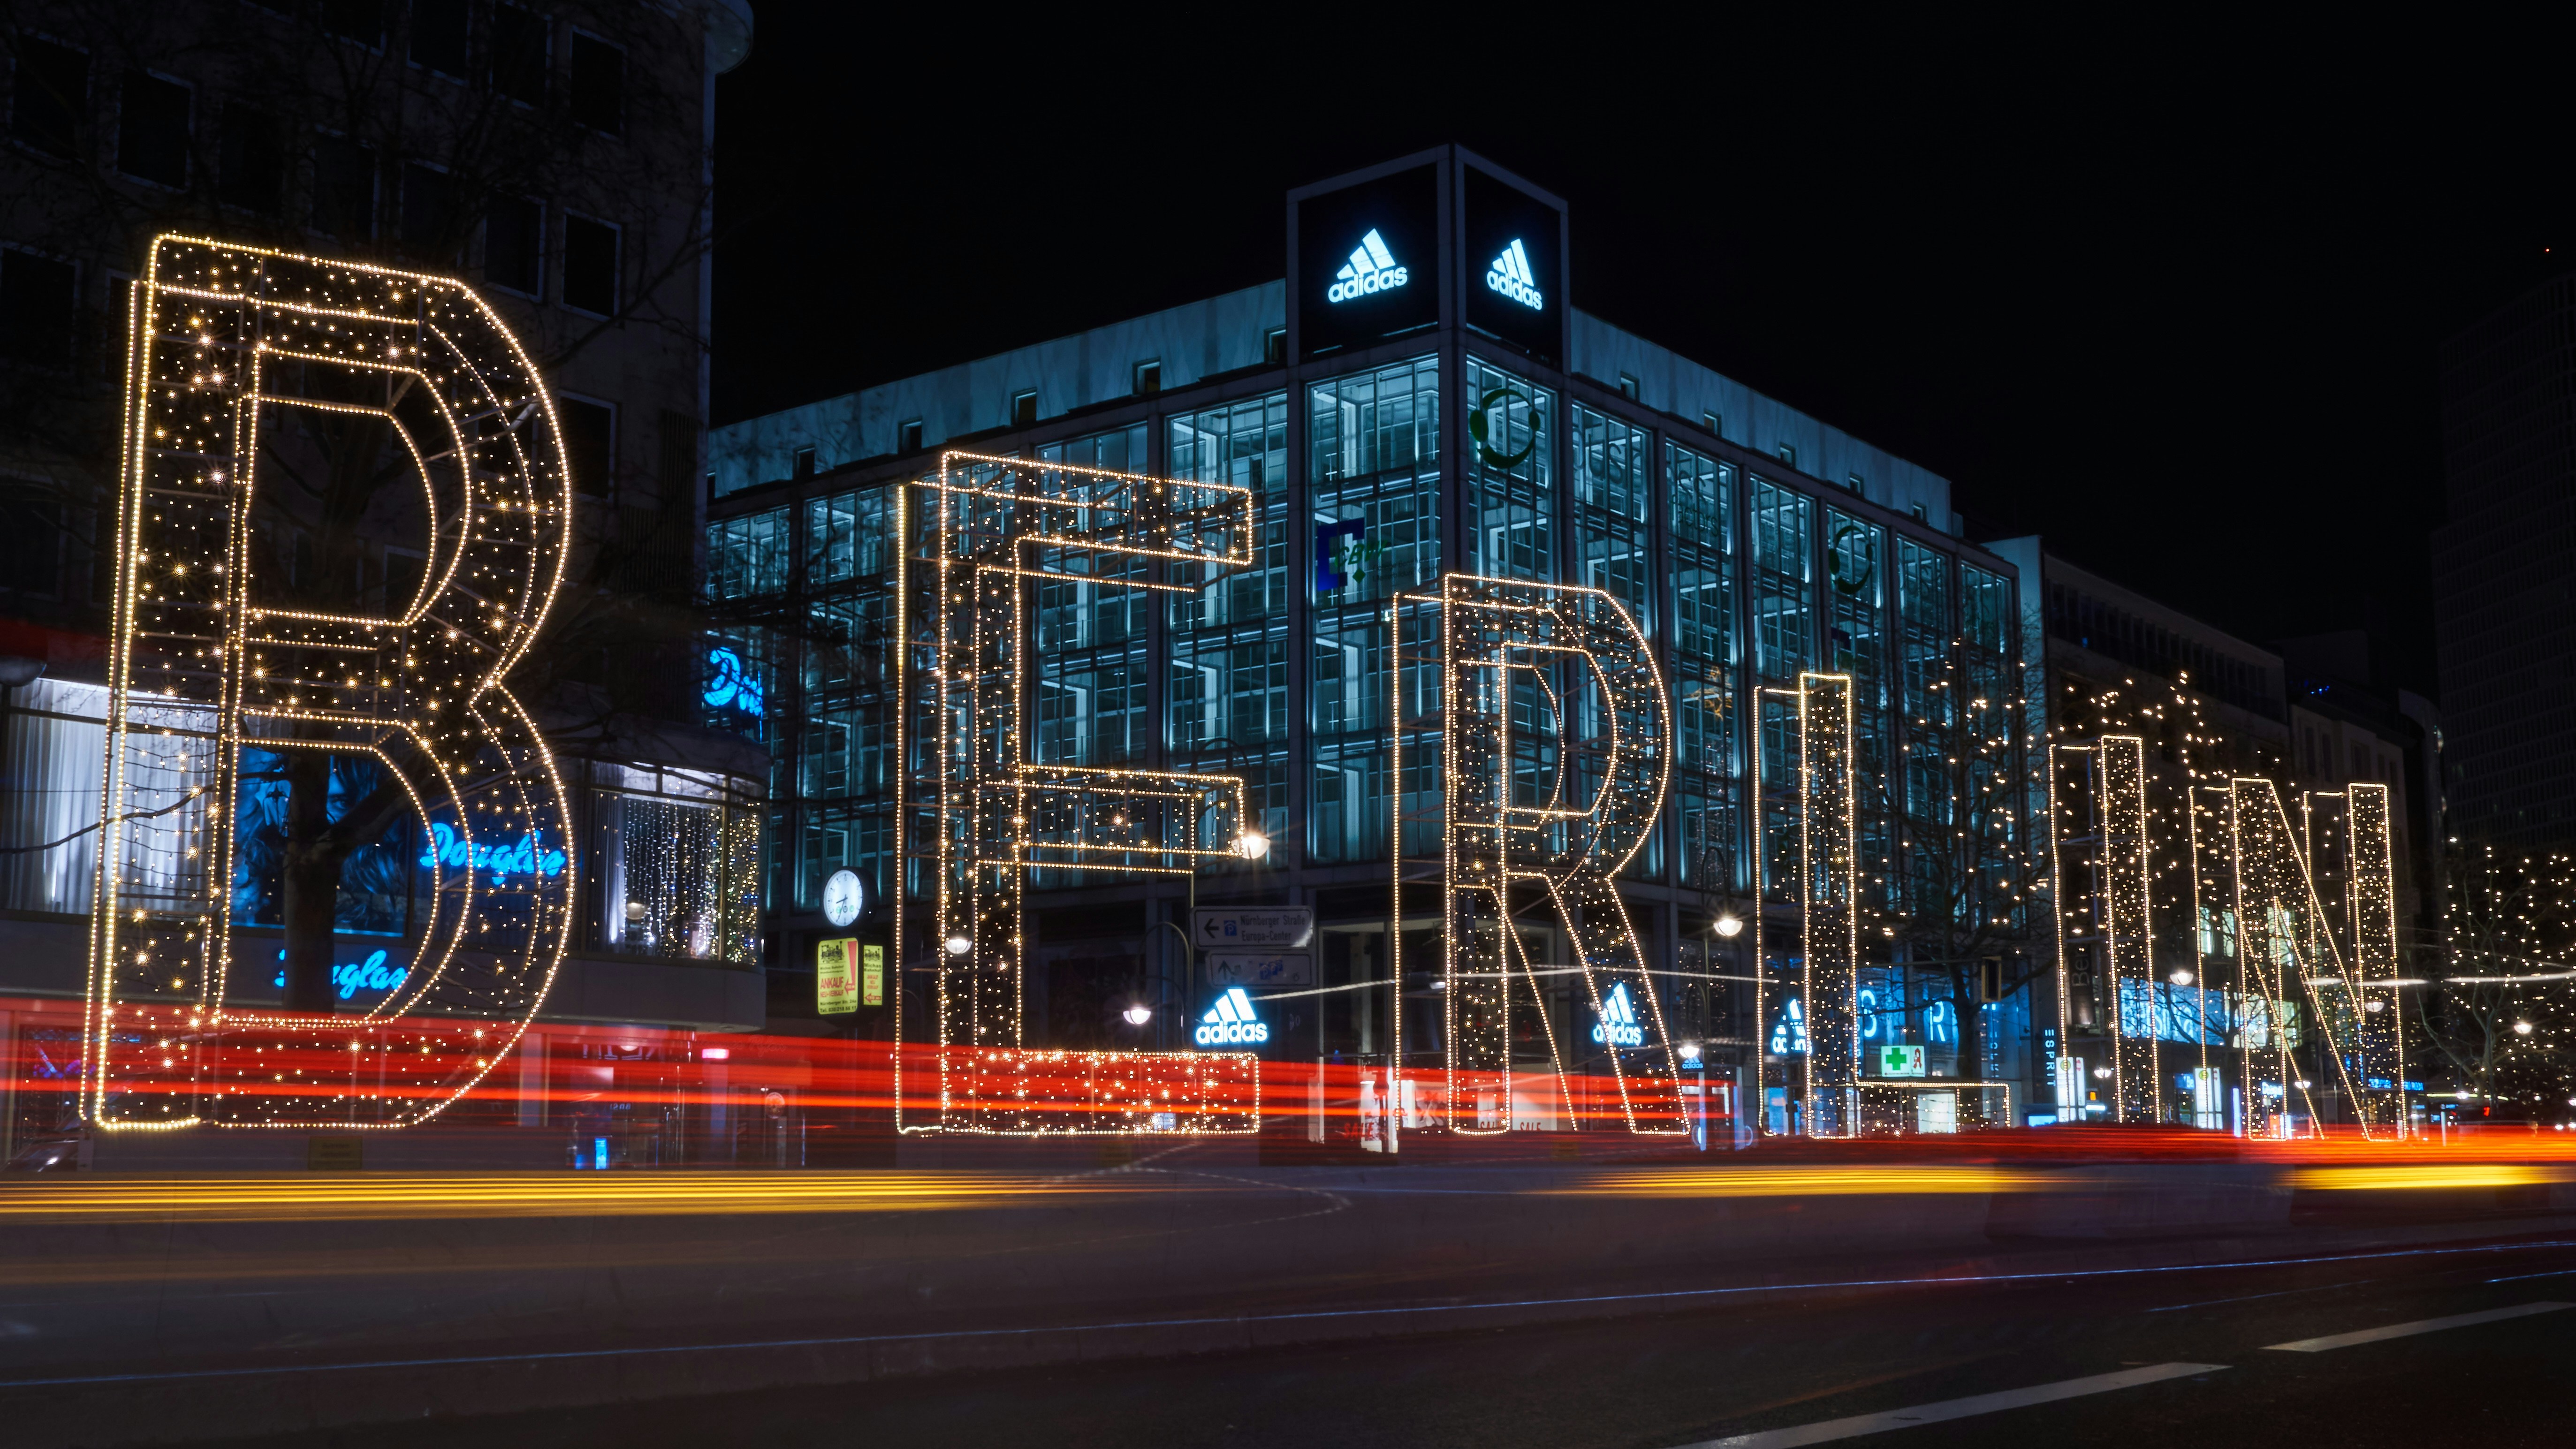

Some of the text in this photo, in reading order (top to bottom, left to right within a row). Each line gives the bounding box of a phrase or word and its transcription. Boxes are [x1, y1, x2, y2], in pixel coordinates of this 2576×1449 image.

[1328, 266, 1408, 303] adidas
[1486, 271, 1543, 311] adidas
[420, 823, 566, 885] Douglas
[1240, 915, 1279, 928] Nürnberger
[1283, 915, 1306, 926] Straße
[1242, 930, 1292, 943] Europa-Center
[820, 976, 843, 989] ANKAUF
[1196, 1021, 1269, 1044] adidas
[2045, 1029, 2056, 1086] ESPRIT
[1344, 1122, 1374, 1139] SALE
